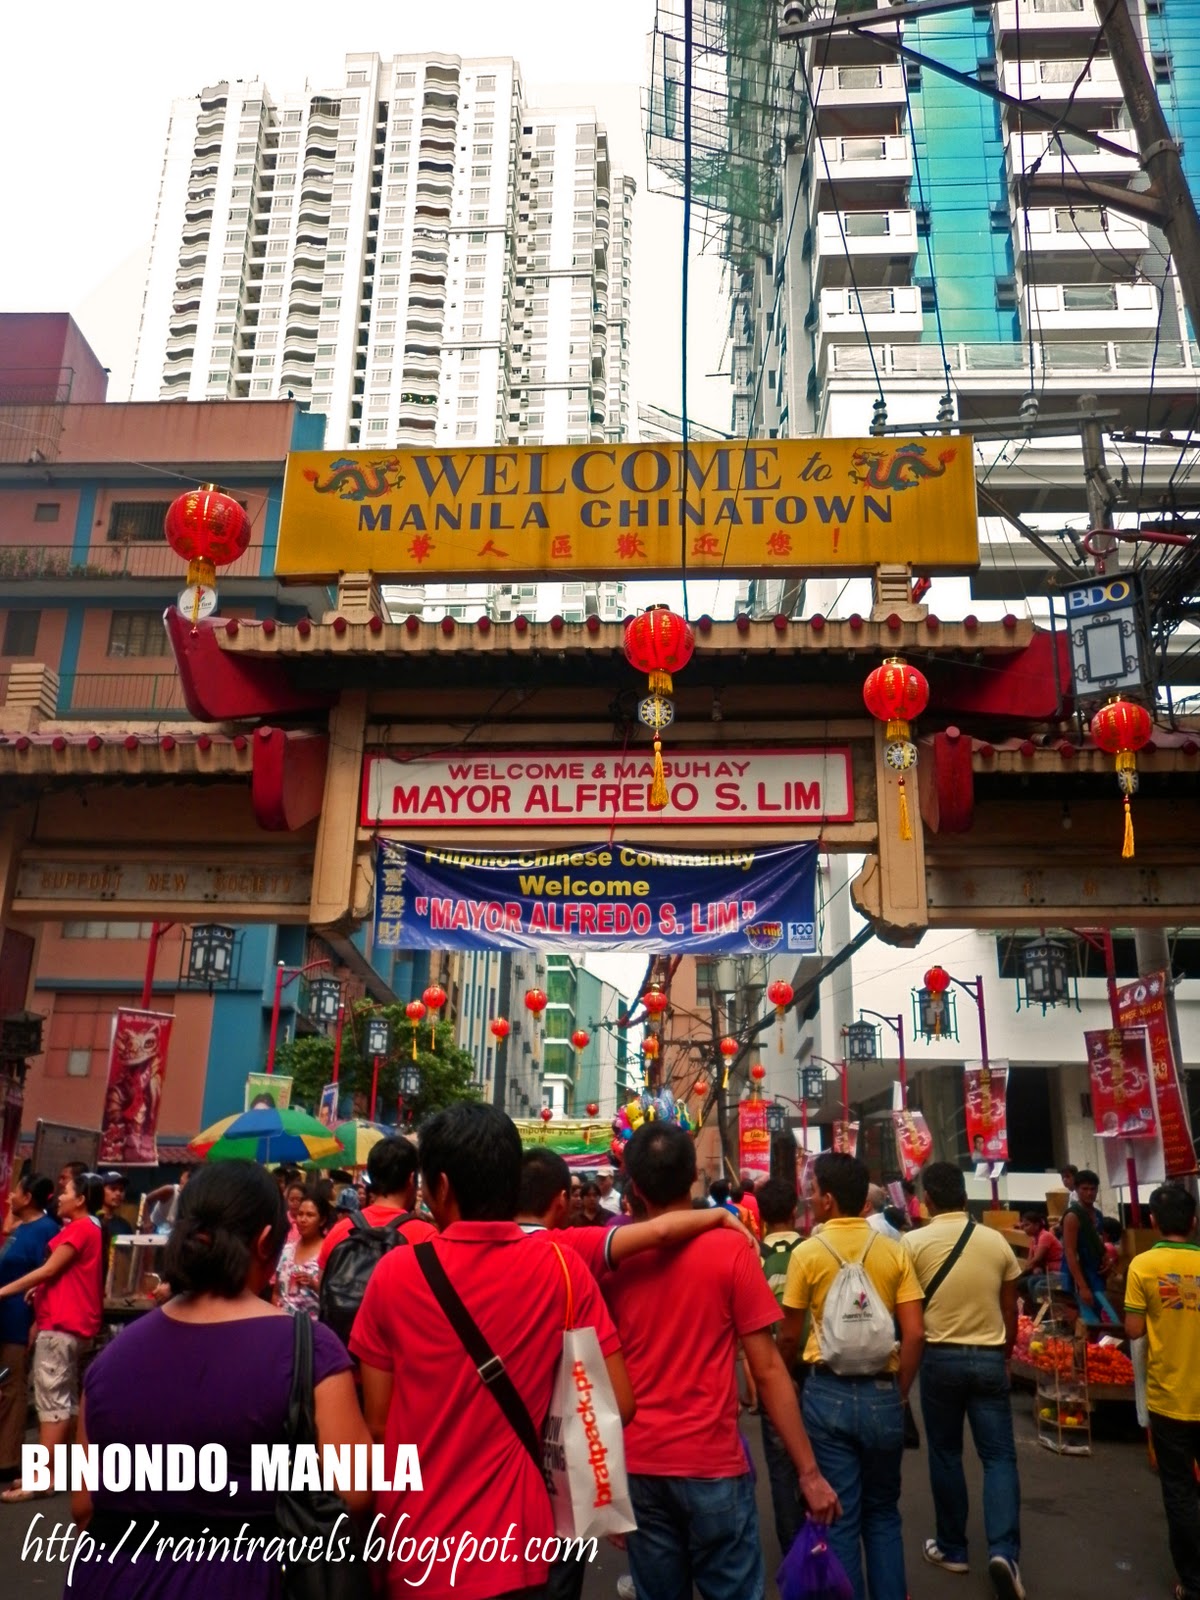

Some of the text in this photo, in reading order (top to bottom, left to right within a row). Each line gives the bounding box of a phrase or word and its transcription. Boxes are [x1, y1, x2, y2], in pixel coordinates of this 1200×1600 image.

[411, 446, 833, 498] WELCOME to
[358, 495, 892, 532] MANILA CHINATOWN
[1068, 581, 1130, 610] BDO
[448, 760, 751, 781] WELCOME & MABUHAY
[392, 785, 511, 814] MAYOR
[715, 782, 748, 813] S.
[757, 781, 822, 811] LIM
[619, 848, 756, 871] Community
[41, 871, 294, 894] SUPPORT NEW SOCIETY
[518, 874, 651, 896] Welcome
[528, 901, 653, 935] ALFREDO
[658, 902, 685, 935] S.
[790, 923, 814, 936] 100
[571, 1361, 613, 1509] bratpack.ph
